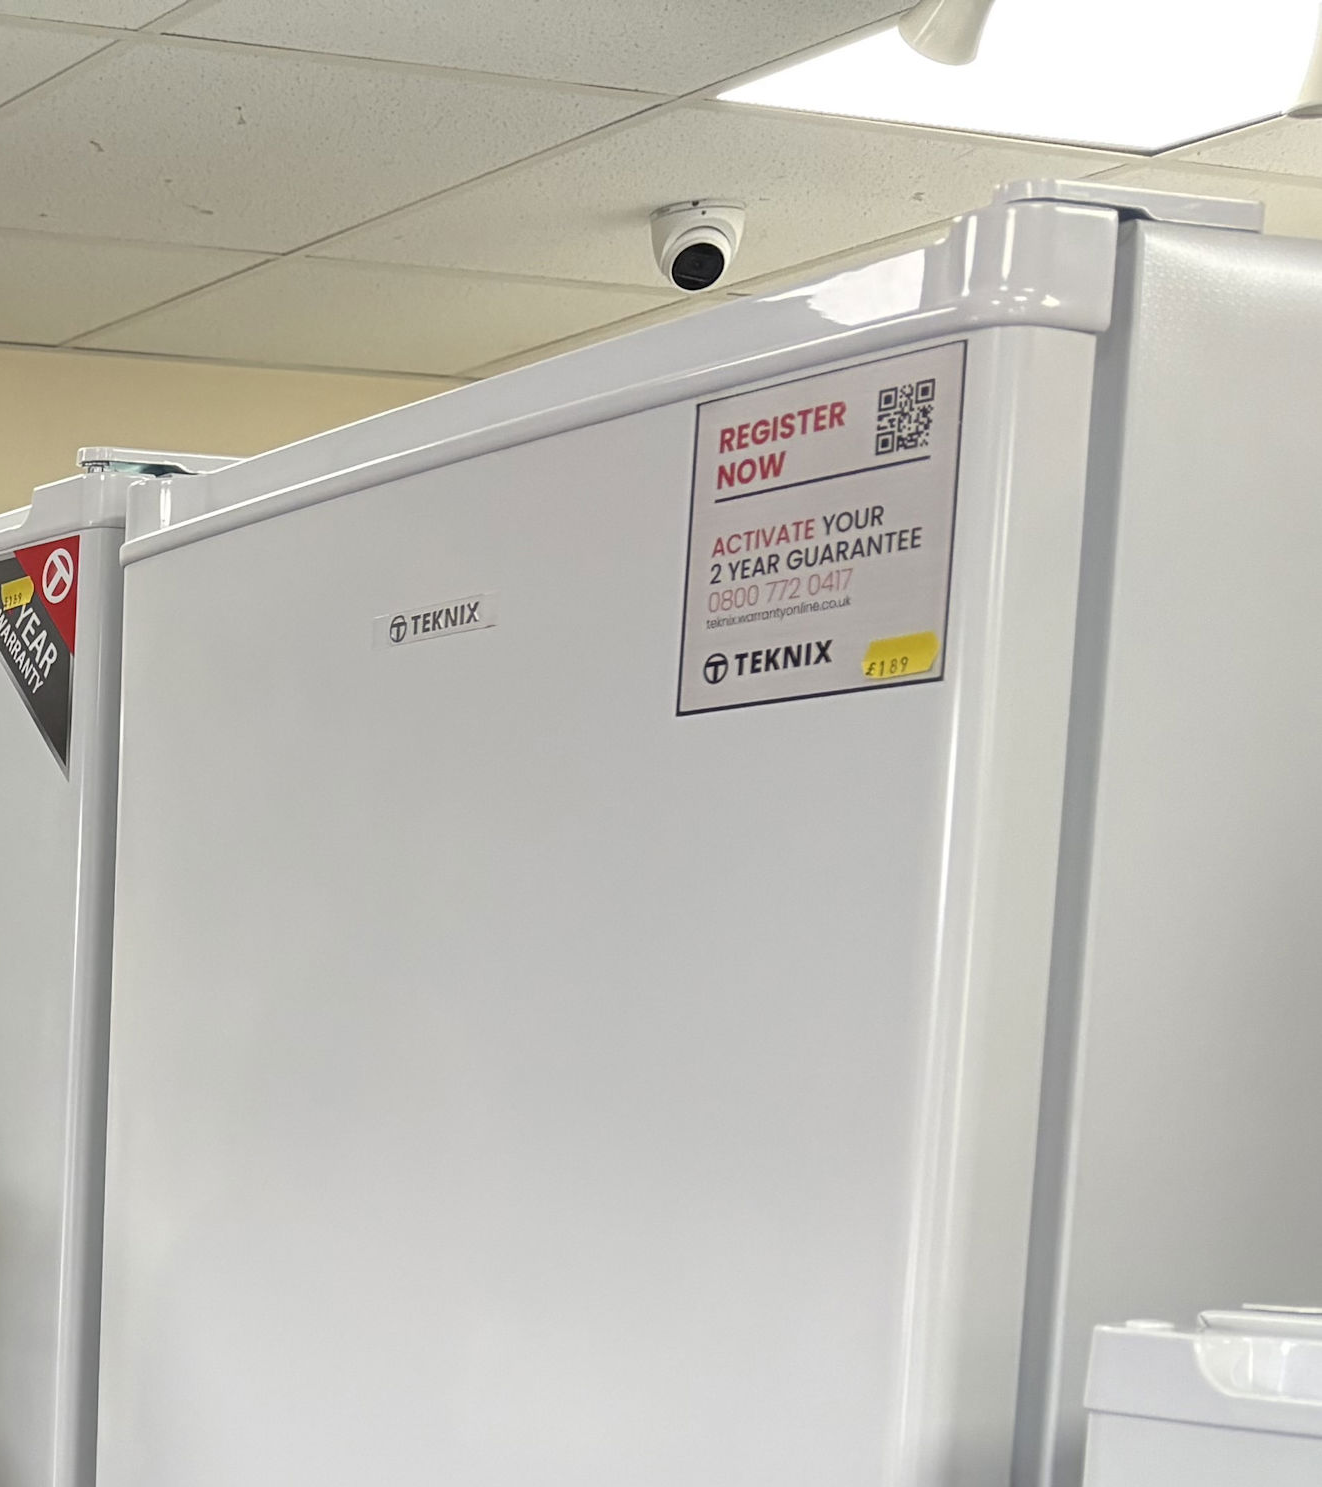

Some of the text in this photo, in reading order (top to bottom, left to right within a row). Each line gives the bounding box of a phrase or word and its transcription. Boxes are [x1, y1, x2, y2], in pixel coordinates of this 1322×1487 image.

[718, 401, 847, 454] REGISTER
[716, 450, 787, 490] NOW
[711, 505, 884, 559] ACTIVATE YOUR
[709, 526, 923, 585] 2 YEAR GUARANTEE
[708, 568, 854, 614] 0800 772 0417
[15, 602, 58, 679] YEAR
[411, 601, 479, 635] TEKNIX
[735, 639, 834, 677] TEKNIX
[865, 655, 909, 677] £189
